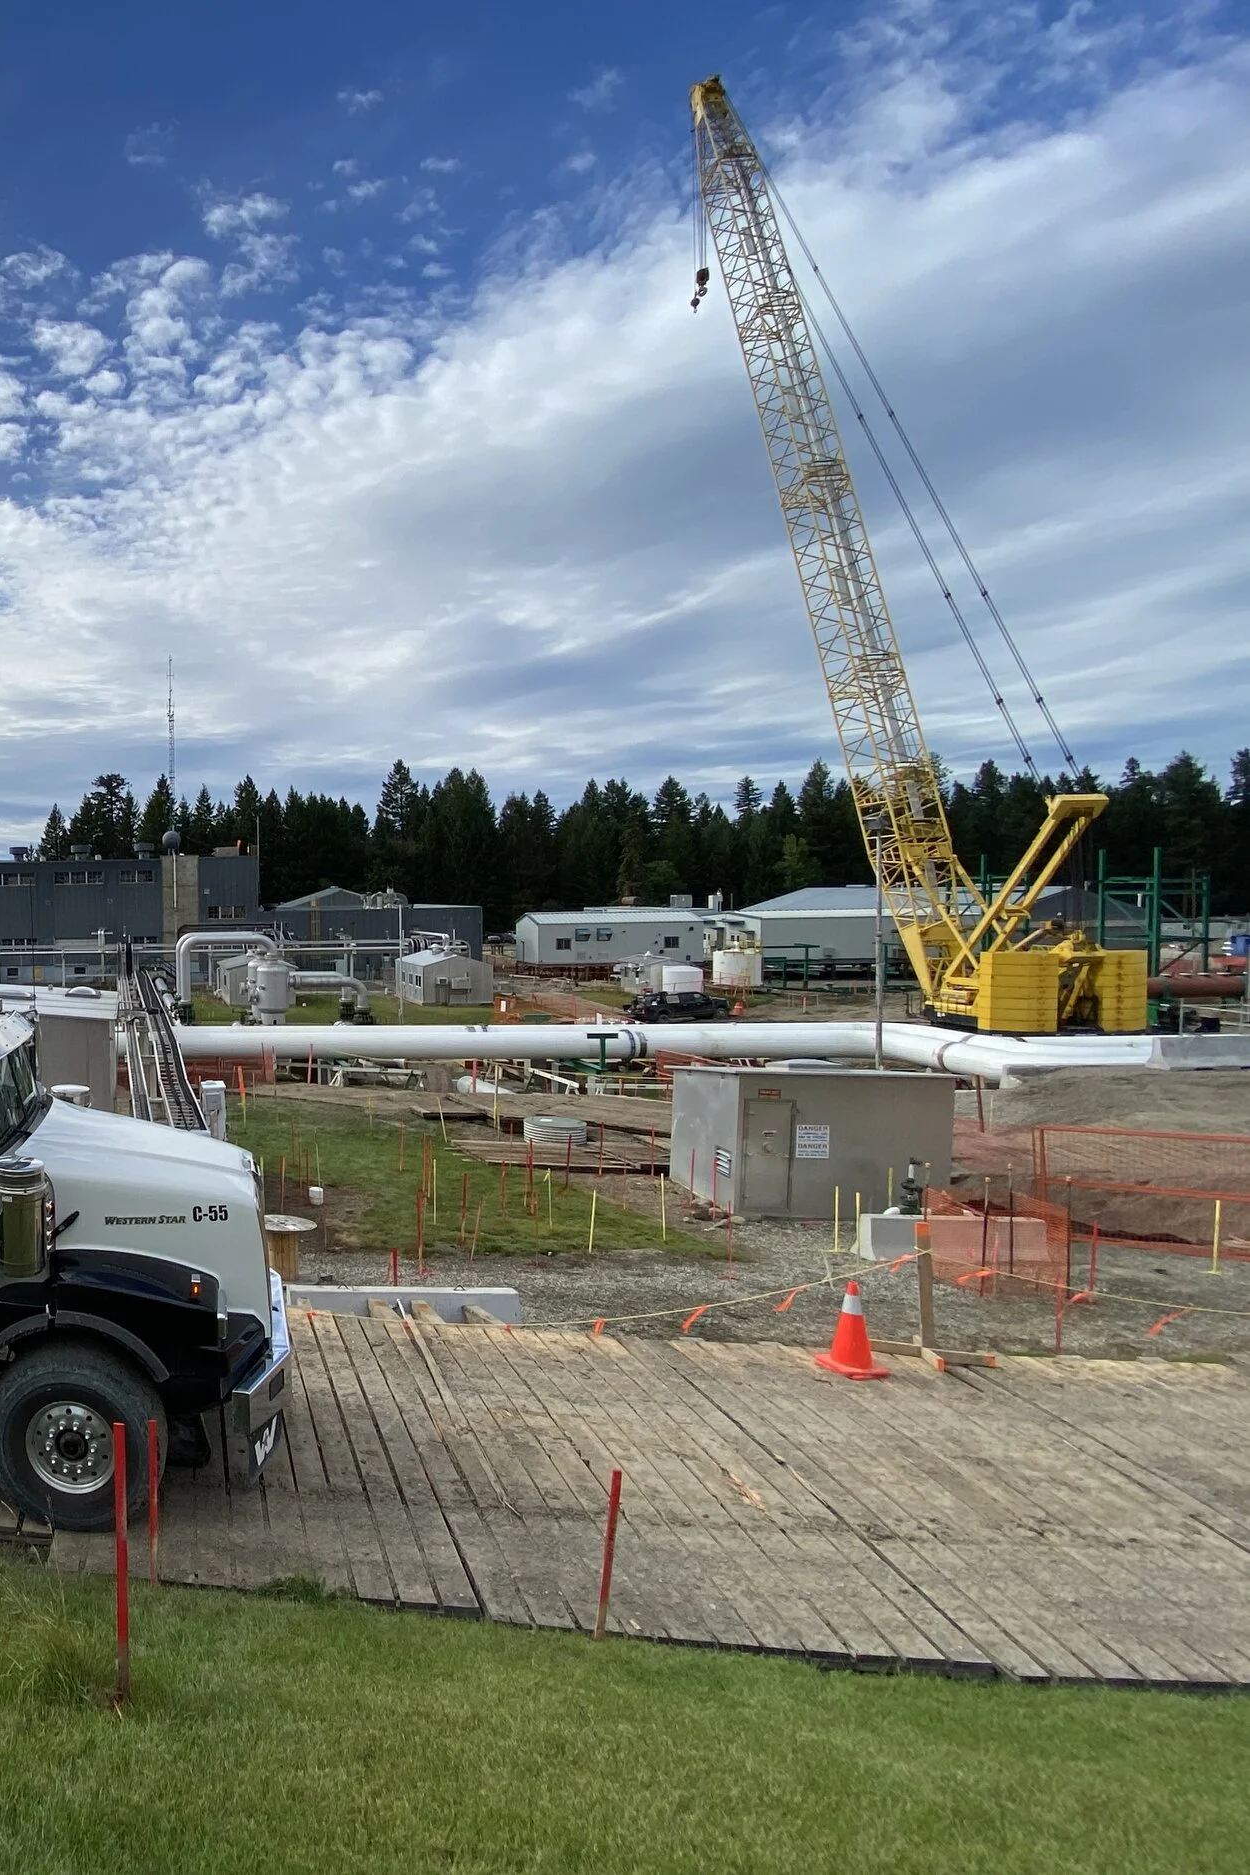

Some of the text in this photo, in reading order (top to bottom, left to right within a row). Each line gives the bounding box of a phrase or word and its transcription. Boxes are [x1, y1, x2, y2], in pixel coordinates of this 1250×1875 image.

[104, 1214, 187, 1225] WESTERN STAR
[192, 1204, 229, 1222] C-55
